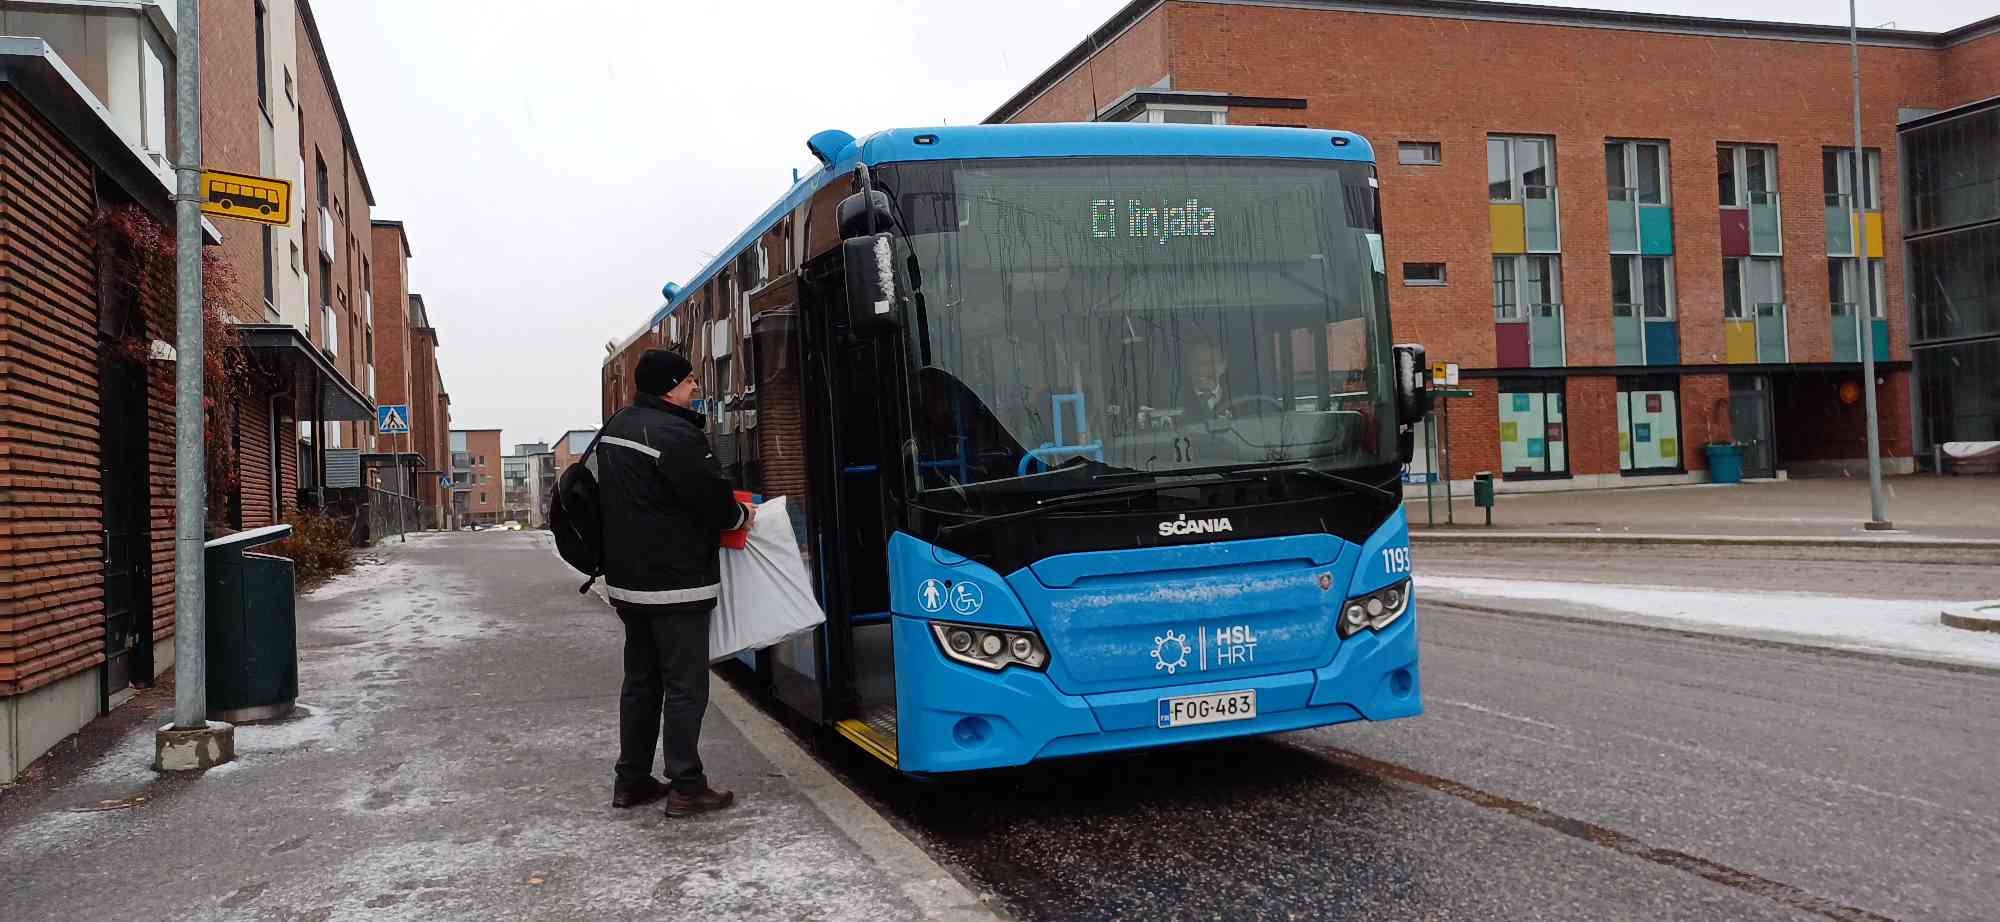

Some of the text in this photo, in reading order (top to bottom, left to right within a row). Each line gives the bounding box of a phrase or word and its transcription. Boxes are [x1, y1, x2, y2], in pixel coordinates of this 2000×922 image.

[1092, 198, 1216, 244] Ei linjalla
[1158, 516, 1233, 537] SCANIA
[1382, 547, 1411, 574] 1193
[1216, 625, 1257, 646] HSL
[1217, 643, 1257, 665] HRT
[1174, 695, 1251, 721] FOG-483
